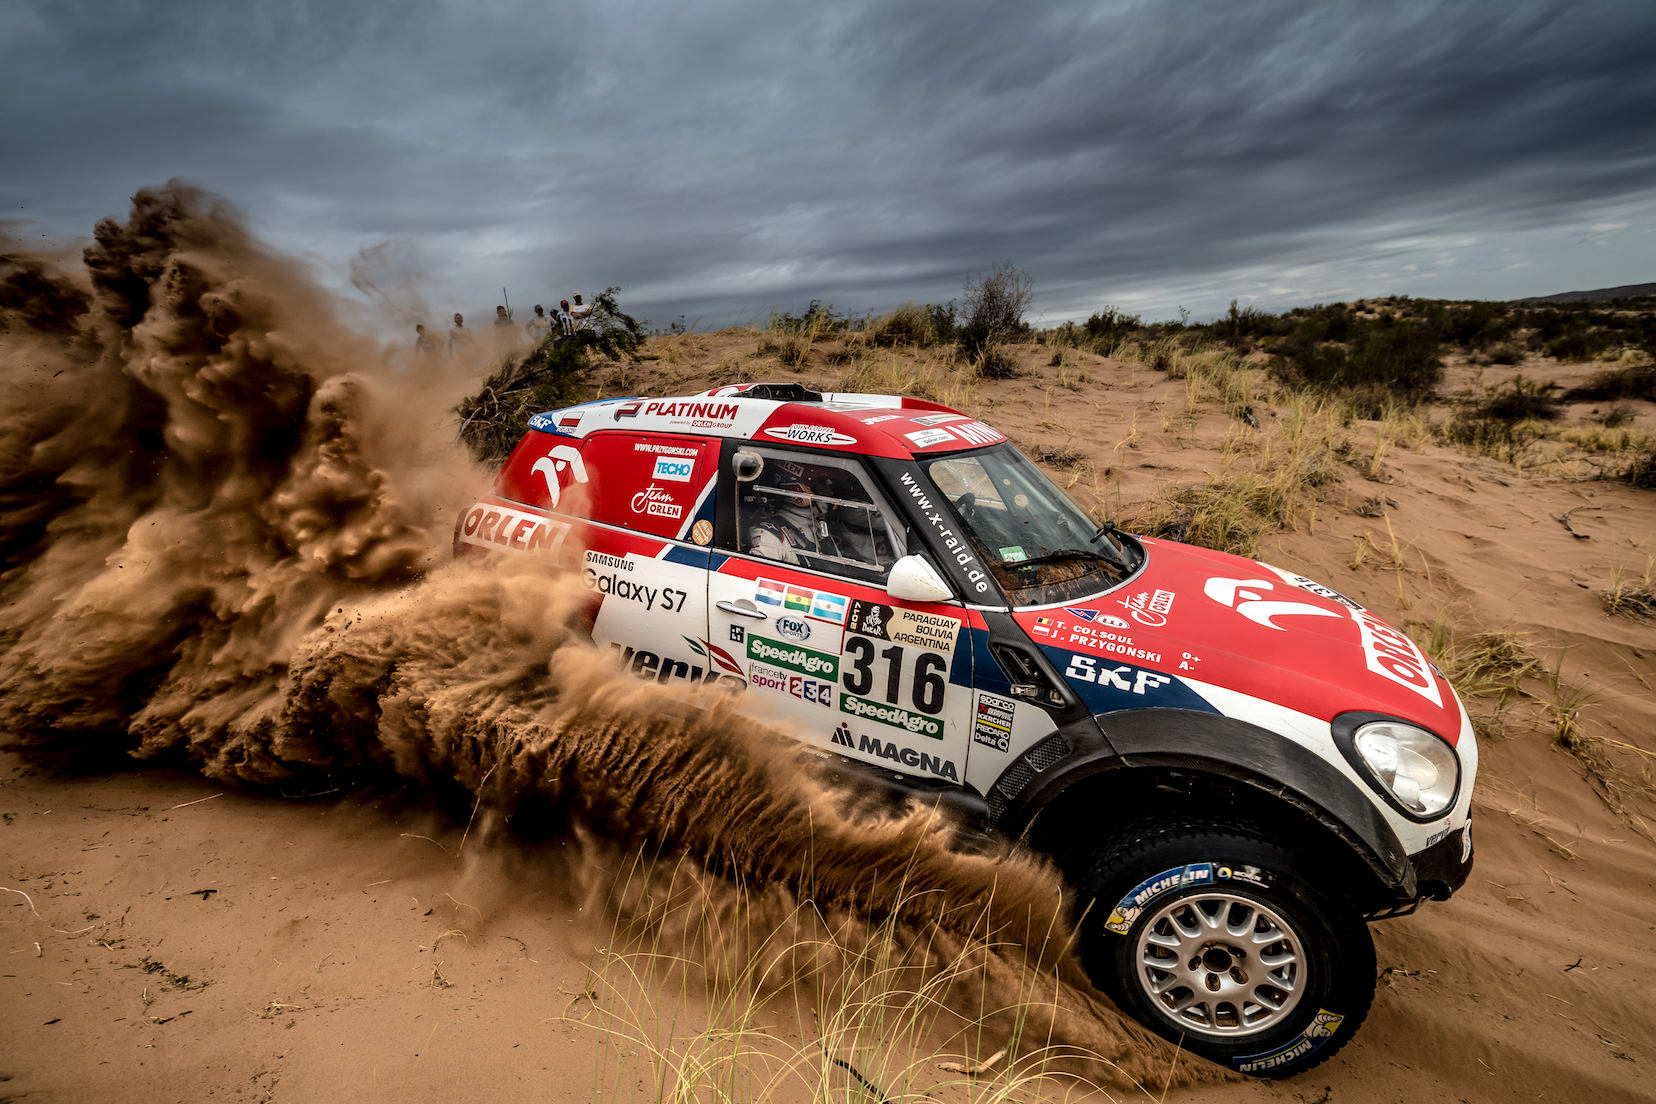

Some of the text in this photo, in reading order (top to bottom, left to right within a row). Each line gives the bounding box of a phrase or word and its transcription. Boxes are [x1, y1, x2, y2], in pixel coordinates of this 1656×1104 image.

[645, 402, 740, 420] PLATINUM
[530, 415, 552, 430] SKF
[693, 420, 712, 428] ORLEN
[712, 421, 733, 429] GROUP
[809, 424, 836, 434] COOPER
[786, 429, 833, 443] WORKS
[634, 443, 699, 457] WWW.PRZYGONSKI.COM
[657, 462, 691, 476] TECHO
[649, 504, 680, 517] ORLEN
[464, 508, 561, 552] ORLEN
[900, 471, 988, 593] www.x-raid.de
[586, 551, 635, 572] SAMSUNG
[581, 568, 688, 613] Galaxy S7
[1151, 590, 1173, 612] ORLEN
[850, 602, 861, 630] 2017
[902, 612, 957, 630] PARAGUAY
[782, 629, 804, 639] SPORTS
[783, 619, 804, 634] FOX
[915, 625, 953, 640] BOLIVIA
[1056, 620, 1135, 646] T. COLSOUL
[893, 632, 950, 652] ARGENTINA
[1050, 629, 1162, 663] J. PRZYGONSKI
[750, 639, 834, 674] SpeedAgro
[752, 674, 787, 692] sport
[843, 636, 947, 715] 316
[1065, 654, 1171, 696] SKF
[980, 695, 1015, 710] sparco
[844, 696, 939, 735] SpeedAgro
[975, 732, 997, 746] Delta
[976, 723, 1010, 740] RECARO
[859, 734, 959, 782] MAGNA
[1239, 1039, 1313, 1072] MICHELIN
